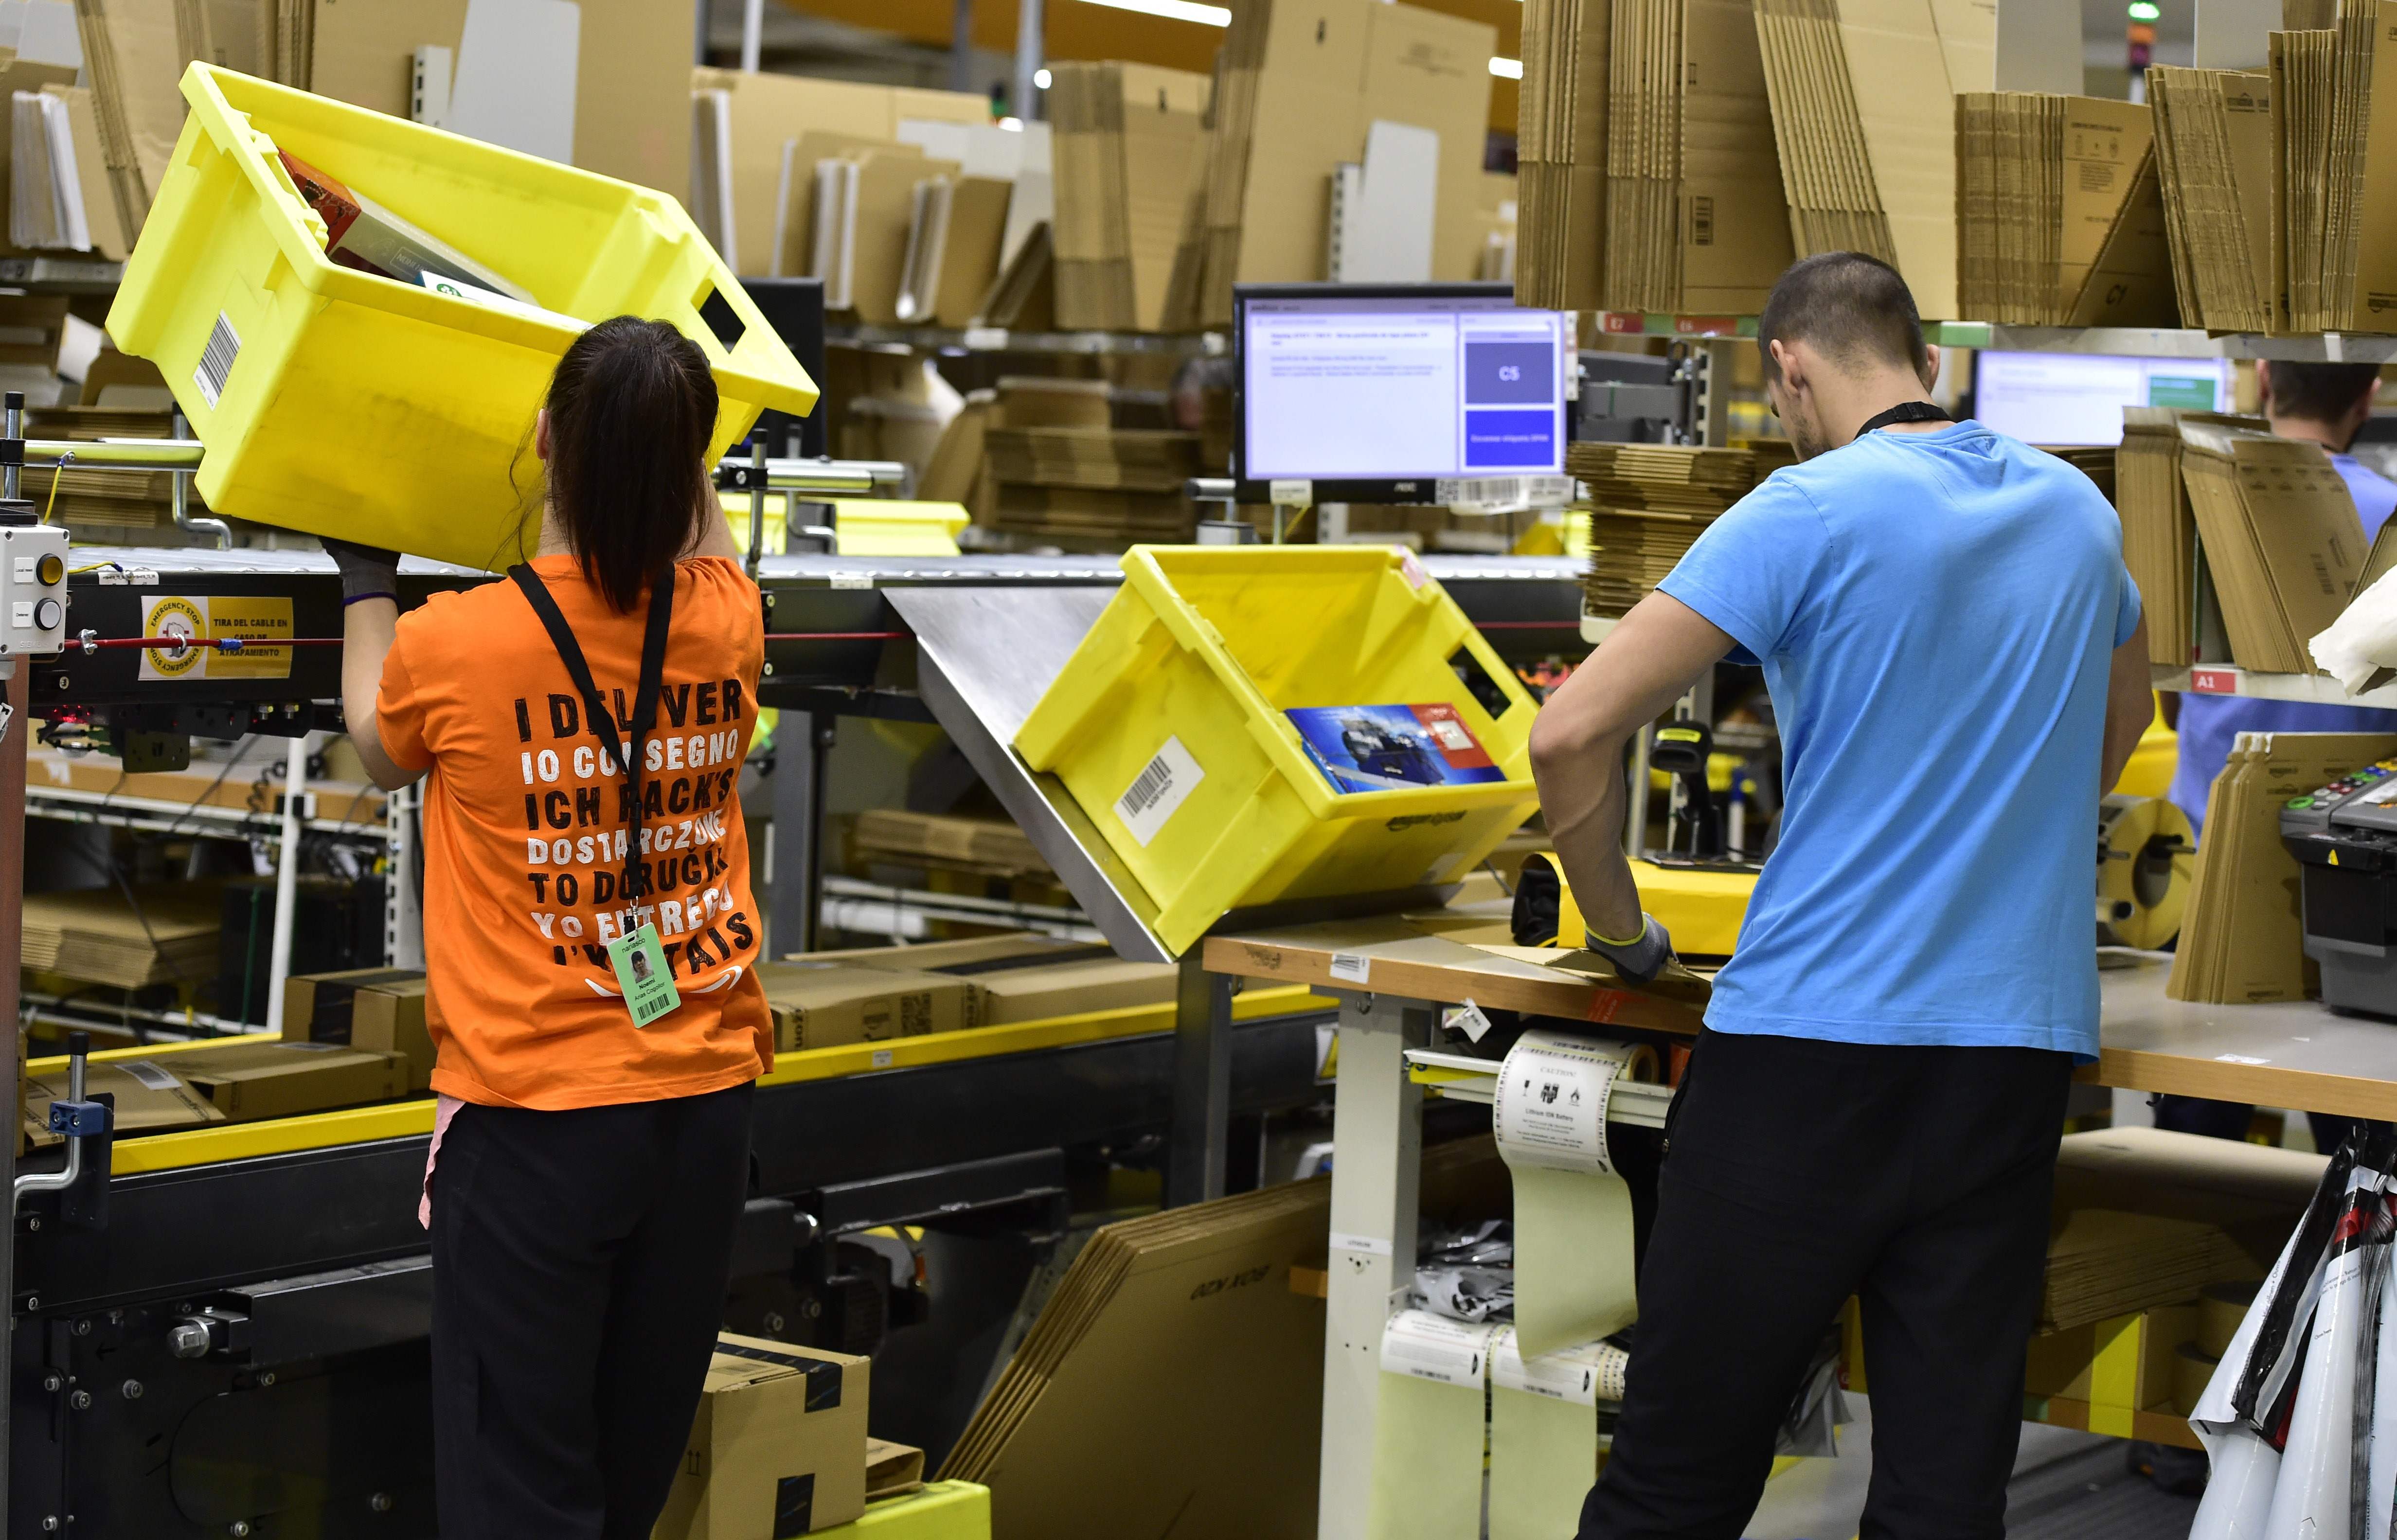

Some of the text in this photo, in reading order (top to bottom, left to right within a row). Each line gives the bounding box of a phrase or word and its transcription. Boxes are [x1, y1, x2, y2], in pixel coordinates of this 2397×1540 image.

[151, 602, 200, 627] EMERGENCY STOP
[214, 619, 232, 627] TIRA
[150, 647, 199, 672] EMERGENCY STOP
[2197, 675, 2216, 689] A1
[515, 679, 742, 743] I DLVER
[521, 749, 560, 785] IO
[525, 786, 601, 831] ICH
[527, 873, 578, 907] TO
[530, 912, 583, 939] YO
[663, 911, 753, 981] TAIS
[639, 978, 656, 990] Noemi
